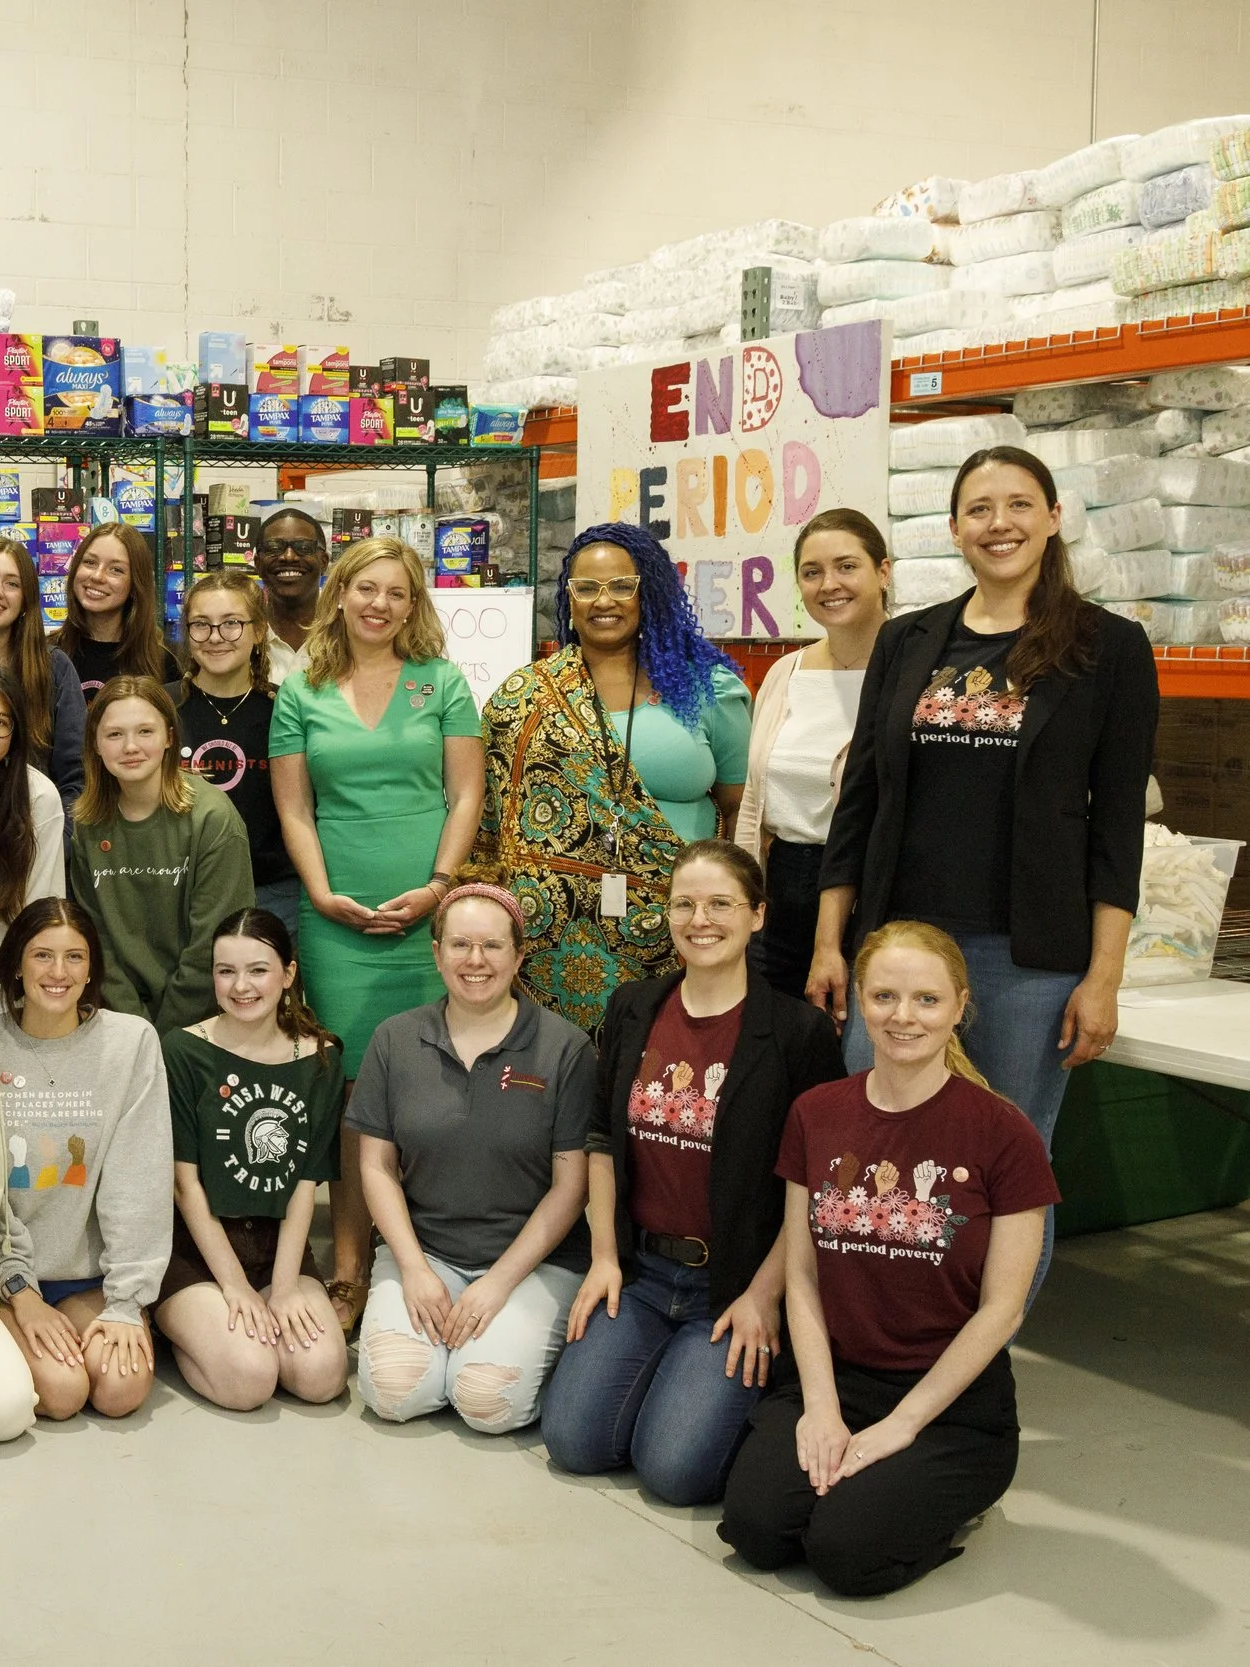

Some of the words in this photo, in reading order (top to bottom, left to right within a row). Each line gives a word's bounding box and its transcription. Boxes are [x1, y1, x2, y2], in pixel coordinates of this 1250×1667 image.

[3, 355, 31, 366] SPORT
[272, 359, 297, 367] tampons
[410, 362, 417, 371] U
[56, 368, 105, 389] always
[360, 368, 367, 378] U
[930, 378, 937, 389] 5
[223, 390, 237, 407] U
[650, 346, 783, 443] END
[410, 397, 424, 414] U
[4, 406, 32, 418] SPORT
[154, 408, 183, 419] always
[223, 408, 238, 416] teen
[258, 411, 290, 421] TAMPAX
[311, 413, 341, 423] TAMPAX
[360, 419, 385, 429] SPORT
[489, 419, 516, 430] always
[57, 491, 65, 500] U
[609, 440, 821, 541] PERIOD
[120, 499, 154, 510] TAMPAX
[200, 497, 207, 506] U
[354, 512, 361, 522] U
[236, 523, 250, 540] U
[45, 541, 73, 550] TAMPAX
[469, 533, 486, 547] vail
[441, 543, 469, 554] TAMPAX
[486, 568, 493, 578] U
[43, 594, 67, 603] TAMP
[920, 732, 971, 745] period
[974, 736, 1020, 748] pover
[181, 759, 268, 771] EMINISTS
[93, 866, 117, 889] you
[119, 866, 144, 876] are
[146, 856, 190, 887] enough
[0, 1091, 35, 1099] WOMEN
[38, 1090, 79, 1099] BELONG
[81, 1090, 93, 1098] IN
[15, 1101, 54, 1109] PLACES
[57, 1100, 92, 1108] WHERE
[221, 1083, 265, 1117] TOSA
[270, 1083, 308, 1124] WEST
[3, 1110, 49, 1118] CISIONS
[51, 1110, 70, 1118] ARE
[72, 1109, 103, 1117] BEING
[639, 1131, 678, 1146] period
[680, 1139, 712, 1153] pover
[817, 1239, 839, 1250] end
[841, 1241, 887, 1255] period
[889, 1247, 944, 1266] poverty
